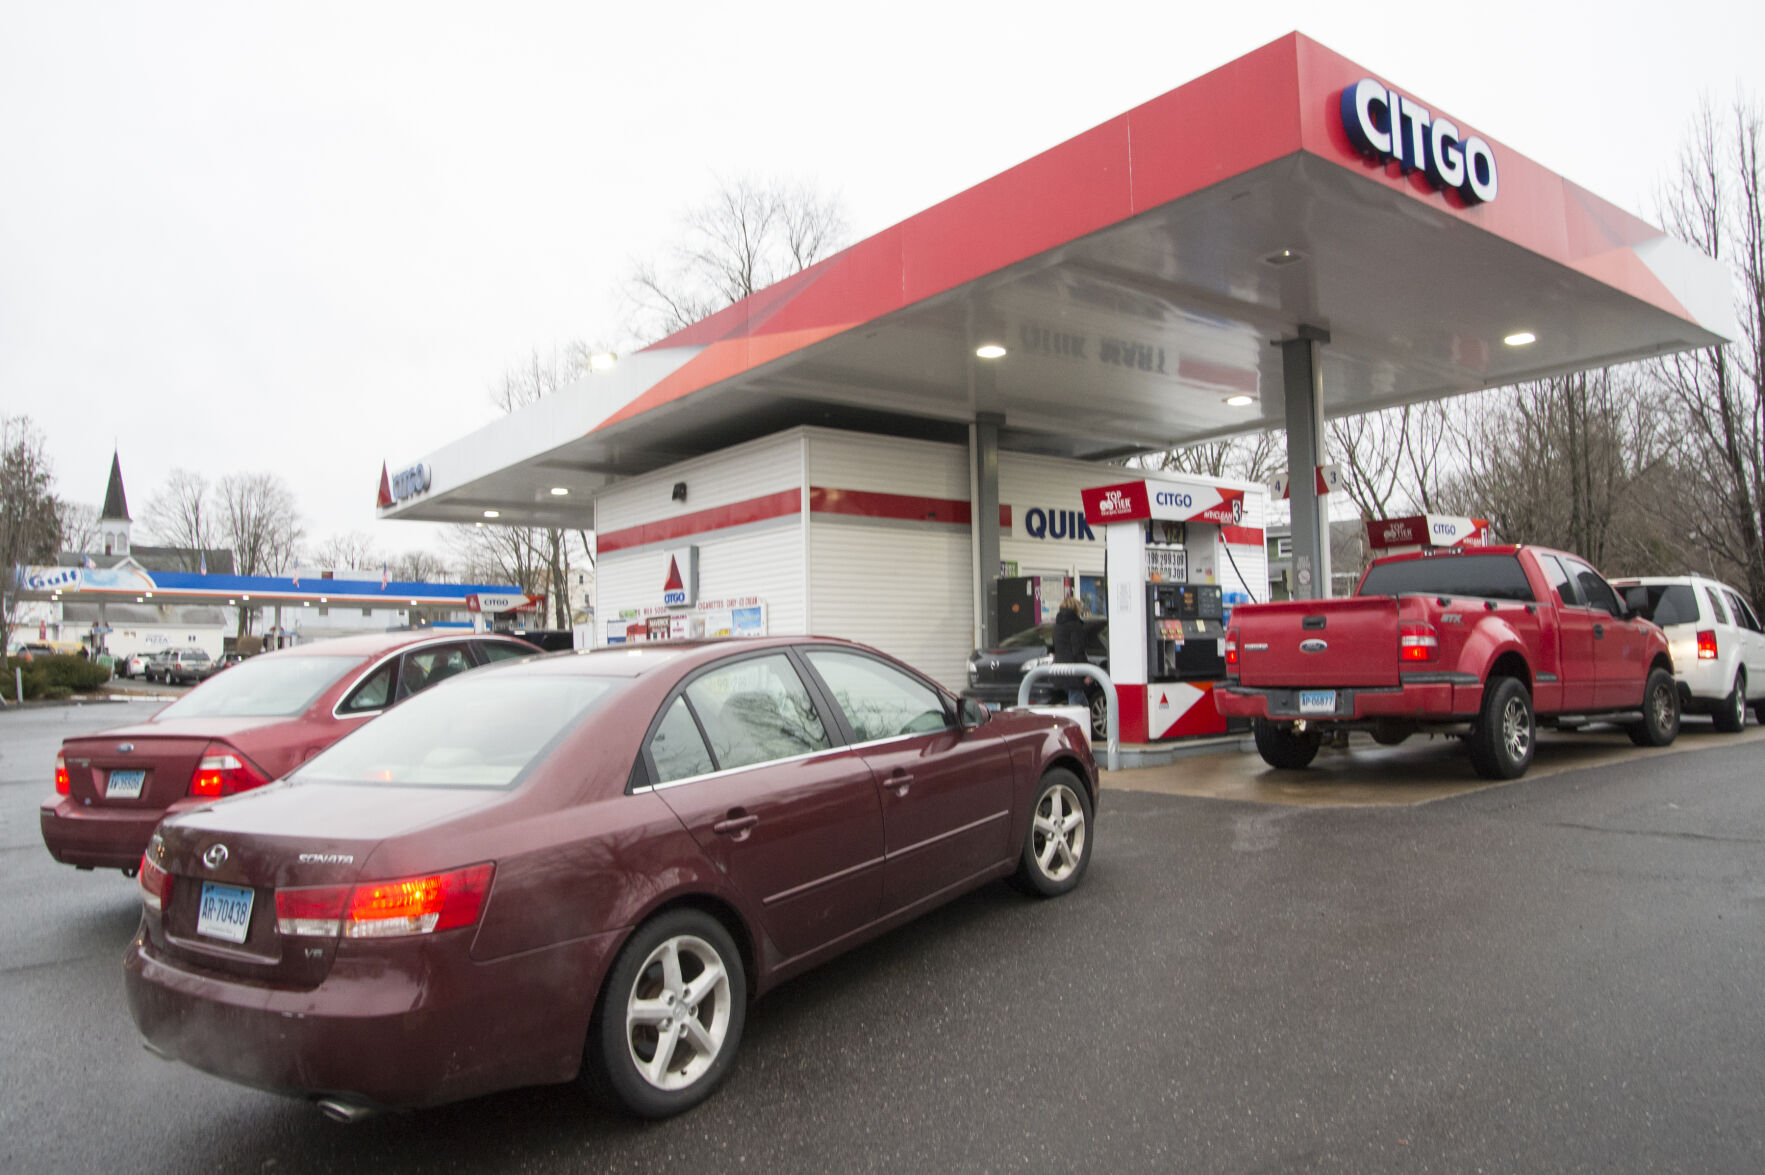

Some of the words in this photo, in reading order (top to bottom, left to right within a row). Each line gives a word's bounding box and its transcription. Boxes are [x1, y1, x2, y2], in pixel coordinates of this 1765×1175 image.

[1344, 77, 1498, 203] CITGO
[1105, 490, 1121, 502] TOP
[1156, 492, 1192, 507] CITGO
[1233, 502, 1241, 524] 3
[1025, 508, 1095, 541] QUIK
[1433, 523, 1456, 536] CITGO
[28, 569, 78, 589] Gulf
[664, 591, 685, 604] CITGO
[299, 853, 354, 865] SONATA
